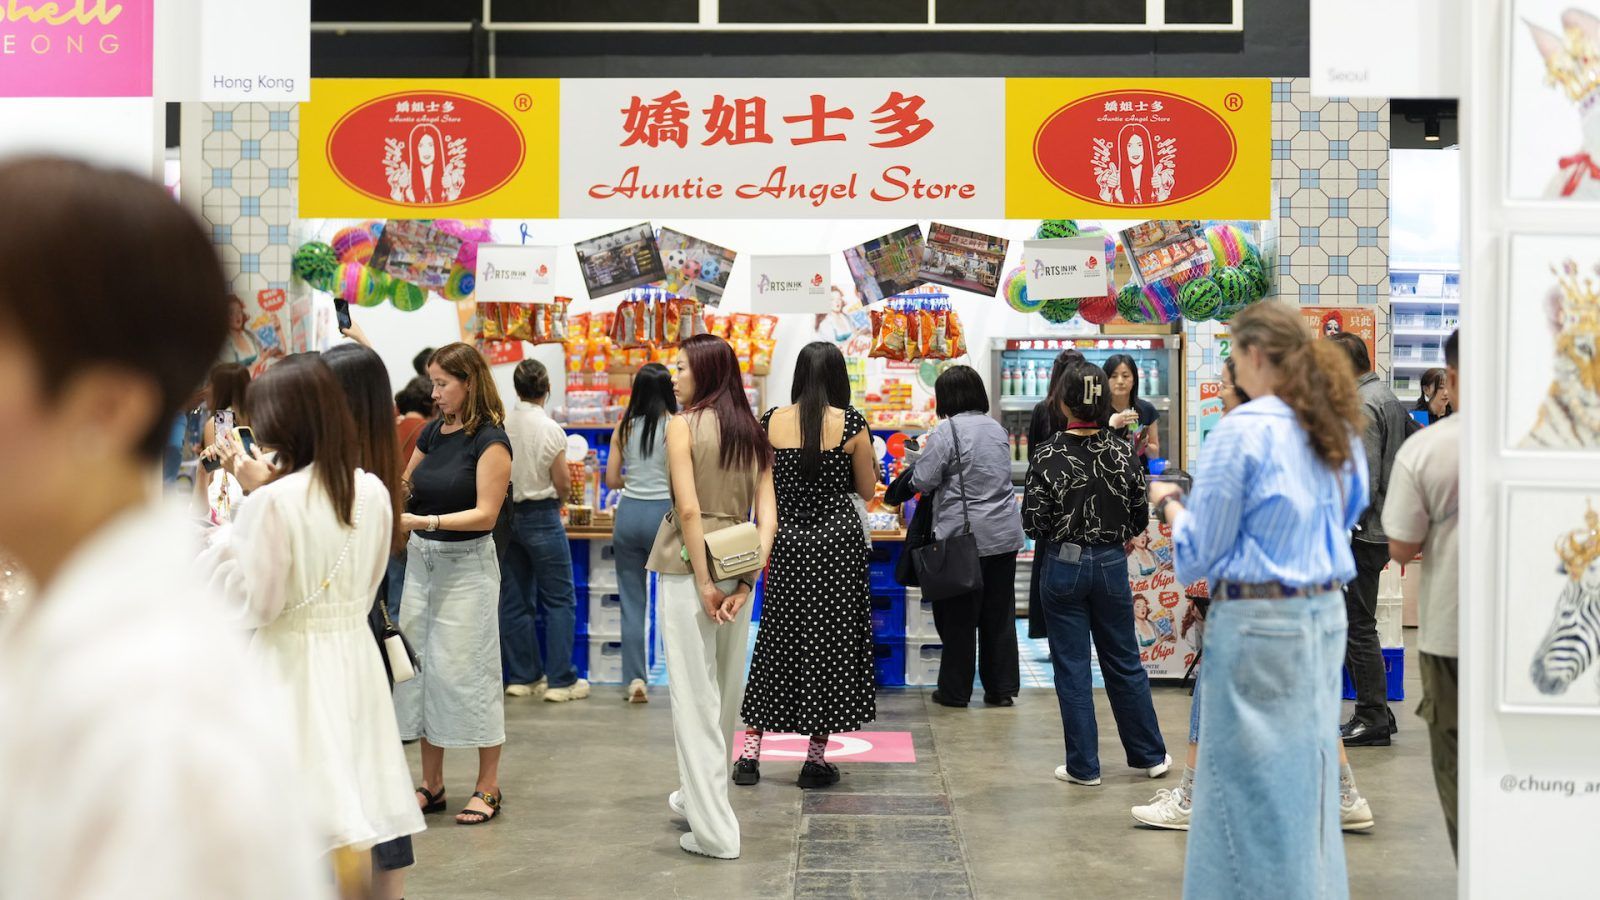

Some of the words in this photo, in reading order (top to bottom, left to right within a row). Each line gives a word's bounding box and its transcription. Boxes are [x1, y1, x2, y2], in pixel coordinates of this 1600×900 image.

[213, 74, 253, 93] Hong
[258, 74, 295, 93] Kong
[388, 114, 415, 123] Auntie
[416, 114, 440, 123] Angel
[440, 114, 462, 123] Store
[618, 90, 935, 149] 嬌姐士多
[1097, 114, 1123, 122] Auntie
[1124, 114, 1149, 123] Angel
[1150, 114, 1171, 122] Store
[588, 165, 724, 200] Auntie
[735, 165, 858, 207] Angel
[870, 165, 977, 202] Store
